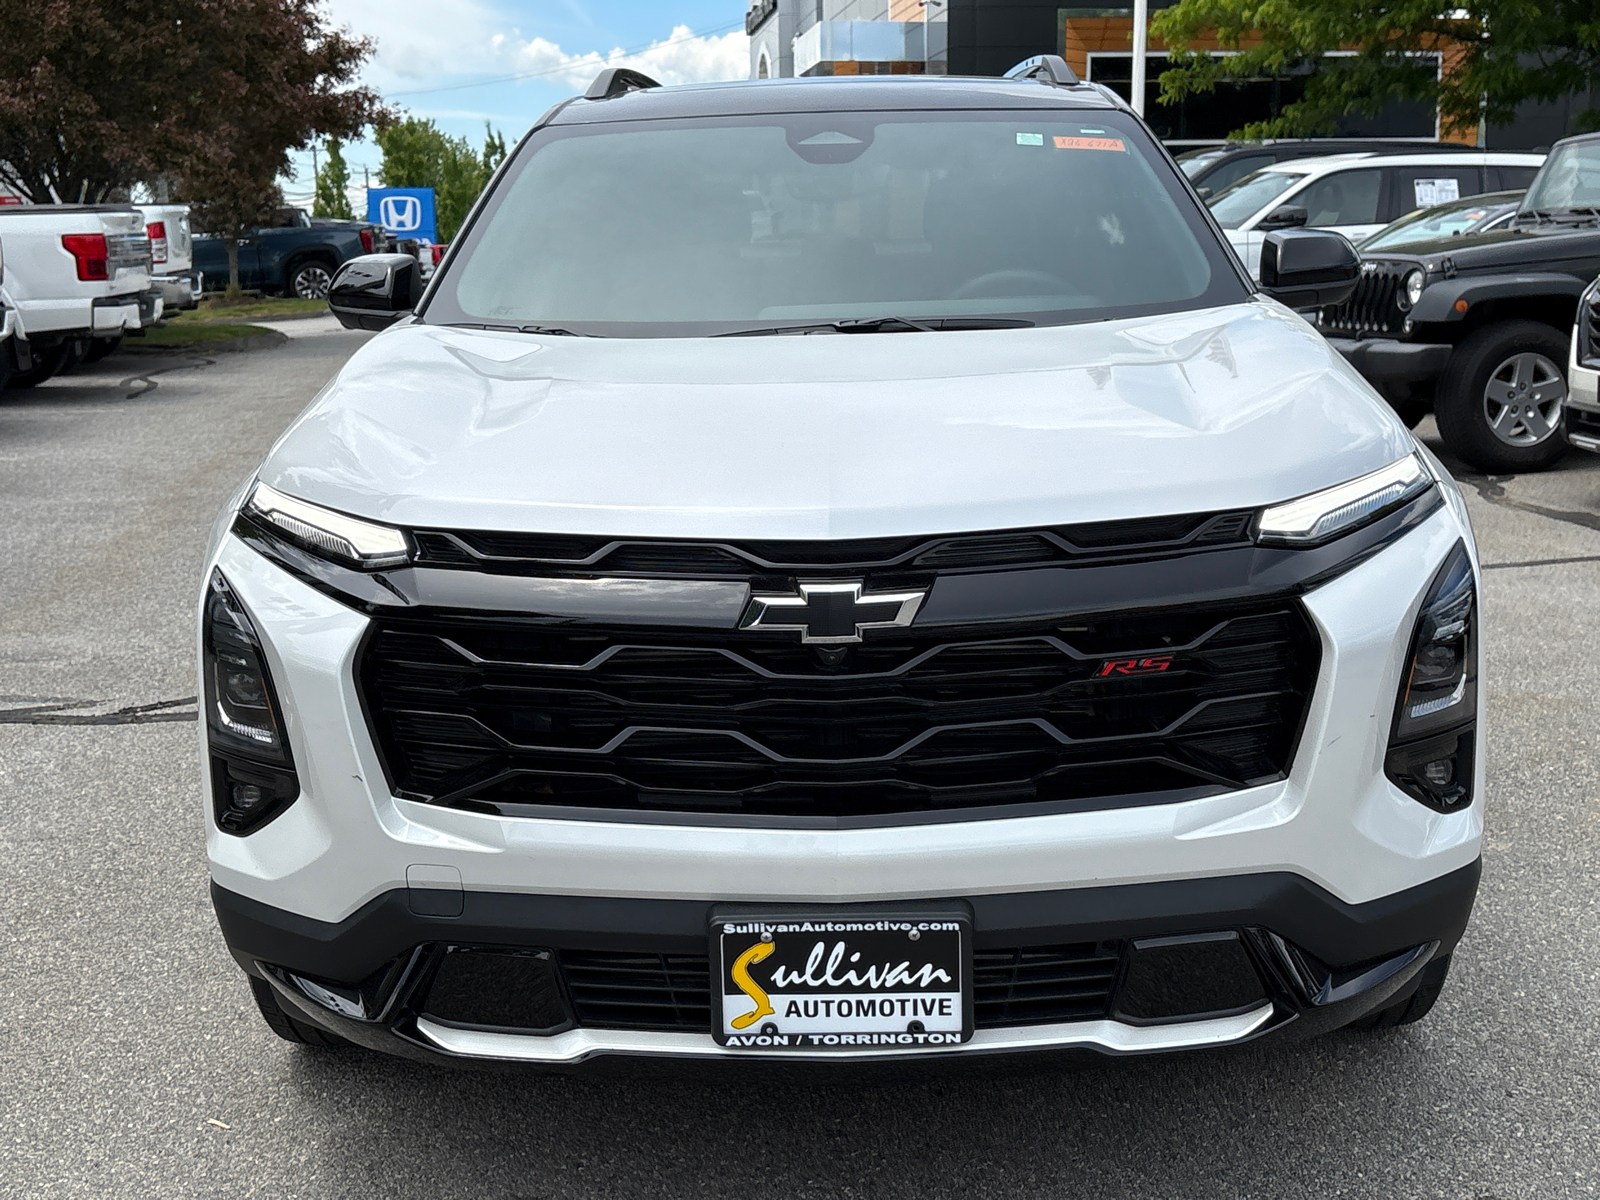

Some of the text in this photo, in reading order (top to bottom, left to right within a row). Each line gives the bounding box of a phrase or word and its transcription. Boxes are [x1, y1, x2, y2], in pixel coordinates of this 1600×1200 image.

[1100, 656, 1173, 676] RS
[723, 921, 960, 934] SullivanAutomotive.com
[731, 941, 952, 1030] Sullivan
[785, 998, 953, 1018] AUTOMOTIVE
[726, 1033, 961, 1046] AVON / TORRINGTON
